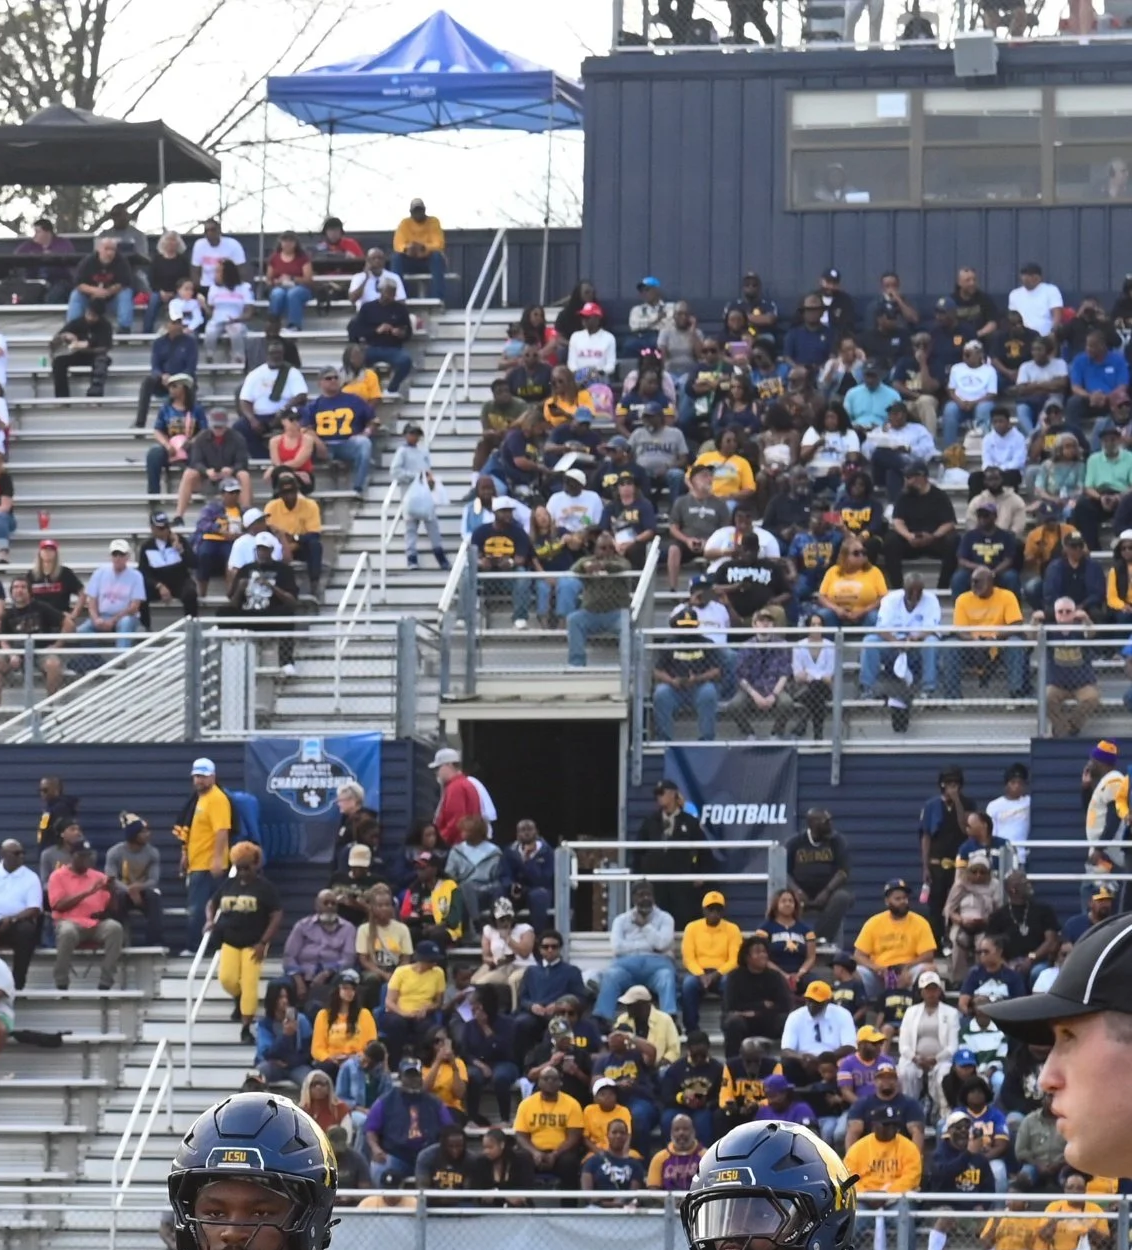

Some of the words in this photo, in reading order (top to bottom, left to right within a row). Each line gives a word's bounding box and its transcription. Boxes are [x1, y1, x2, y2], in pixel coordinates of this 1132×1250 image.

[700, 803, 788, 825] FOOTBALL
[222, 1151, 247, 1162] JCSU
[716, 1170, 739, 1182] JCSU
